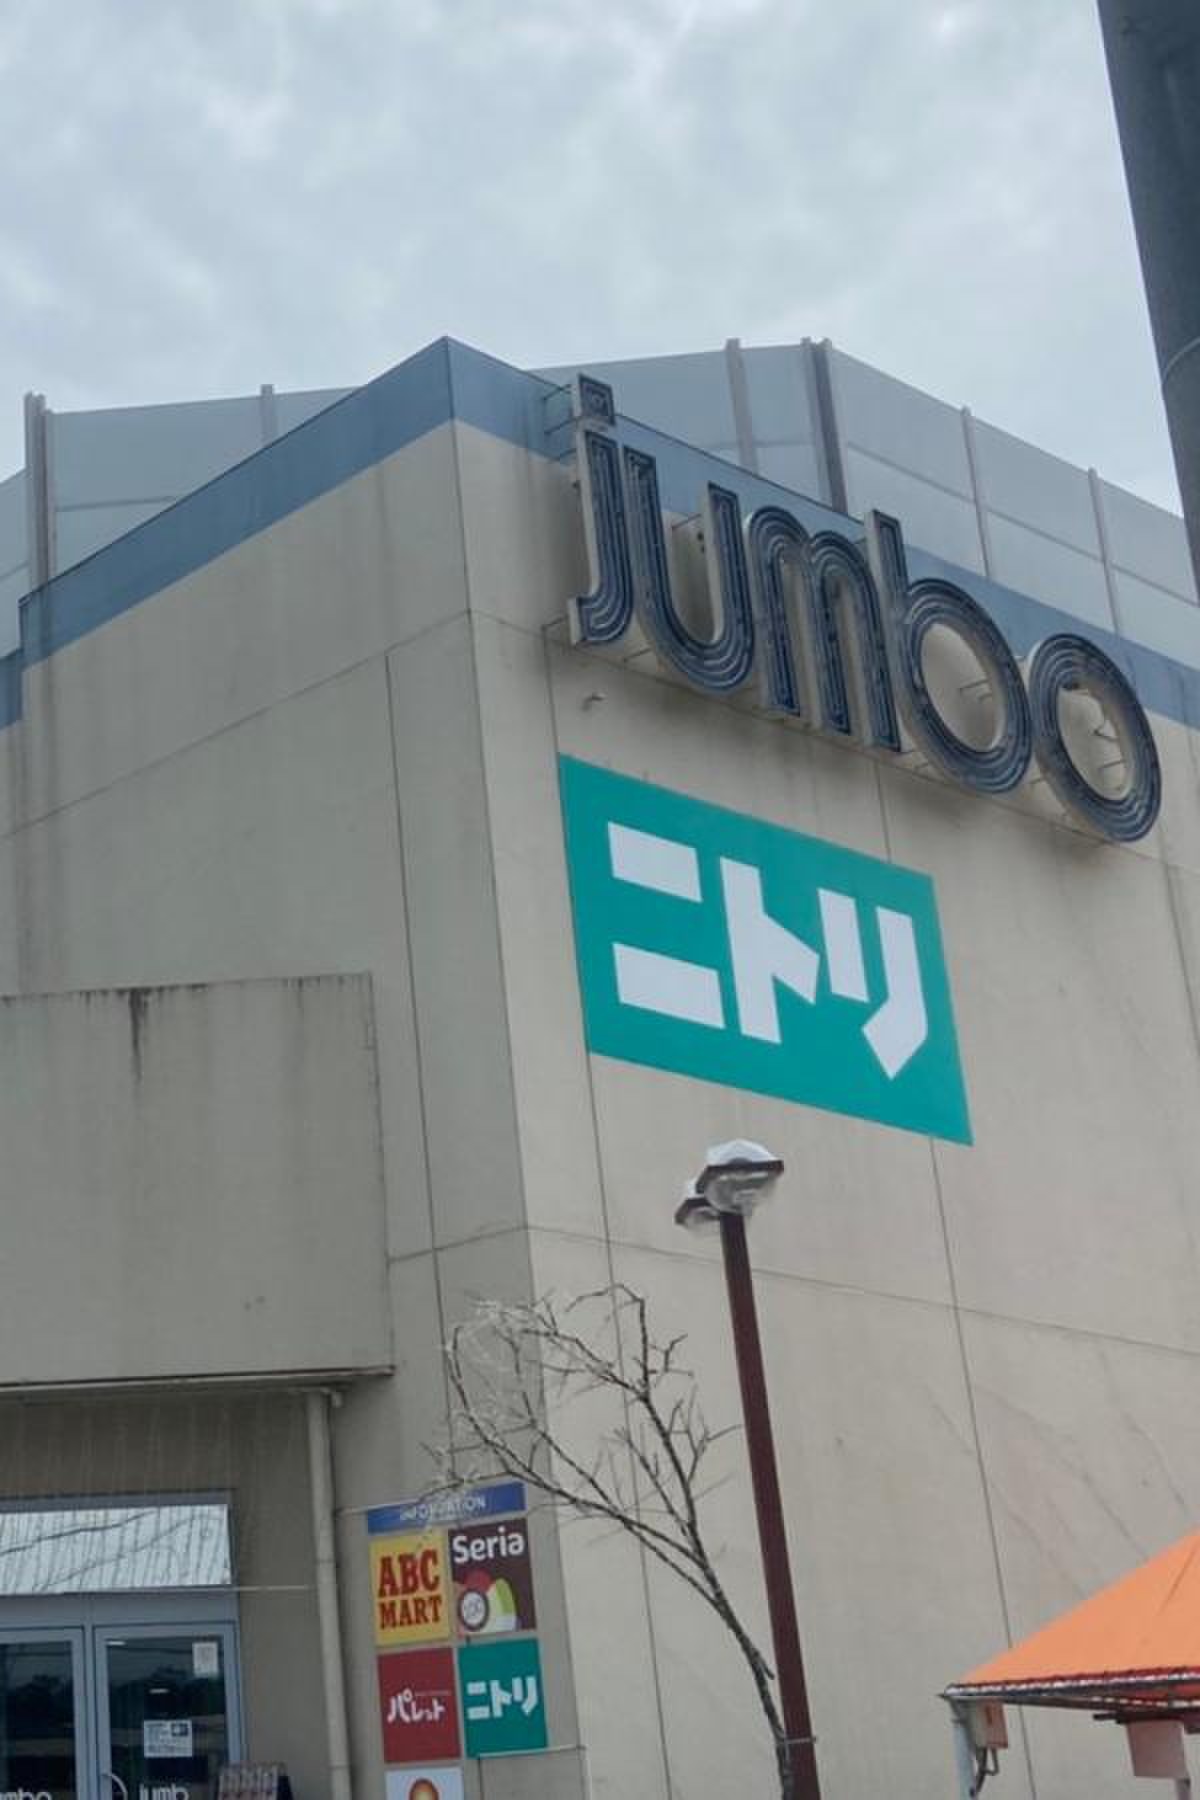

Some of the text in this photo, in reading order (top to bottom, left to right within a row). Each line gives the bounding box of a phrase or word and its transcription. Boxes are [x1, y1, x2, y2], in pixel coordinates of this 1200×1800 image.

[570, 372, 1164, 844] jumbo
[607, 821, 929, 1081] ニトリ
[452, 1526, 525, 1565] Seria
[377, 1548, 440, 1599] ABC
[379, 1595, 442, 1630] MART
[387, 1688, 446, 1723] パレット
[466, 1676, 538, 1721] ニトリ
